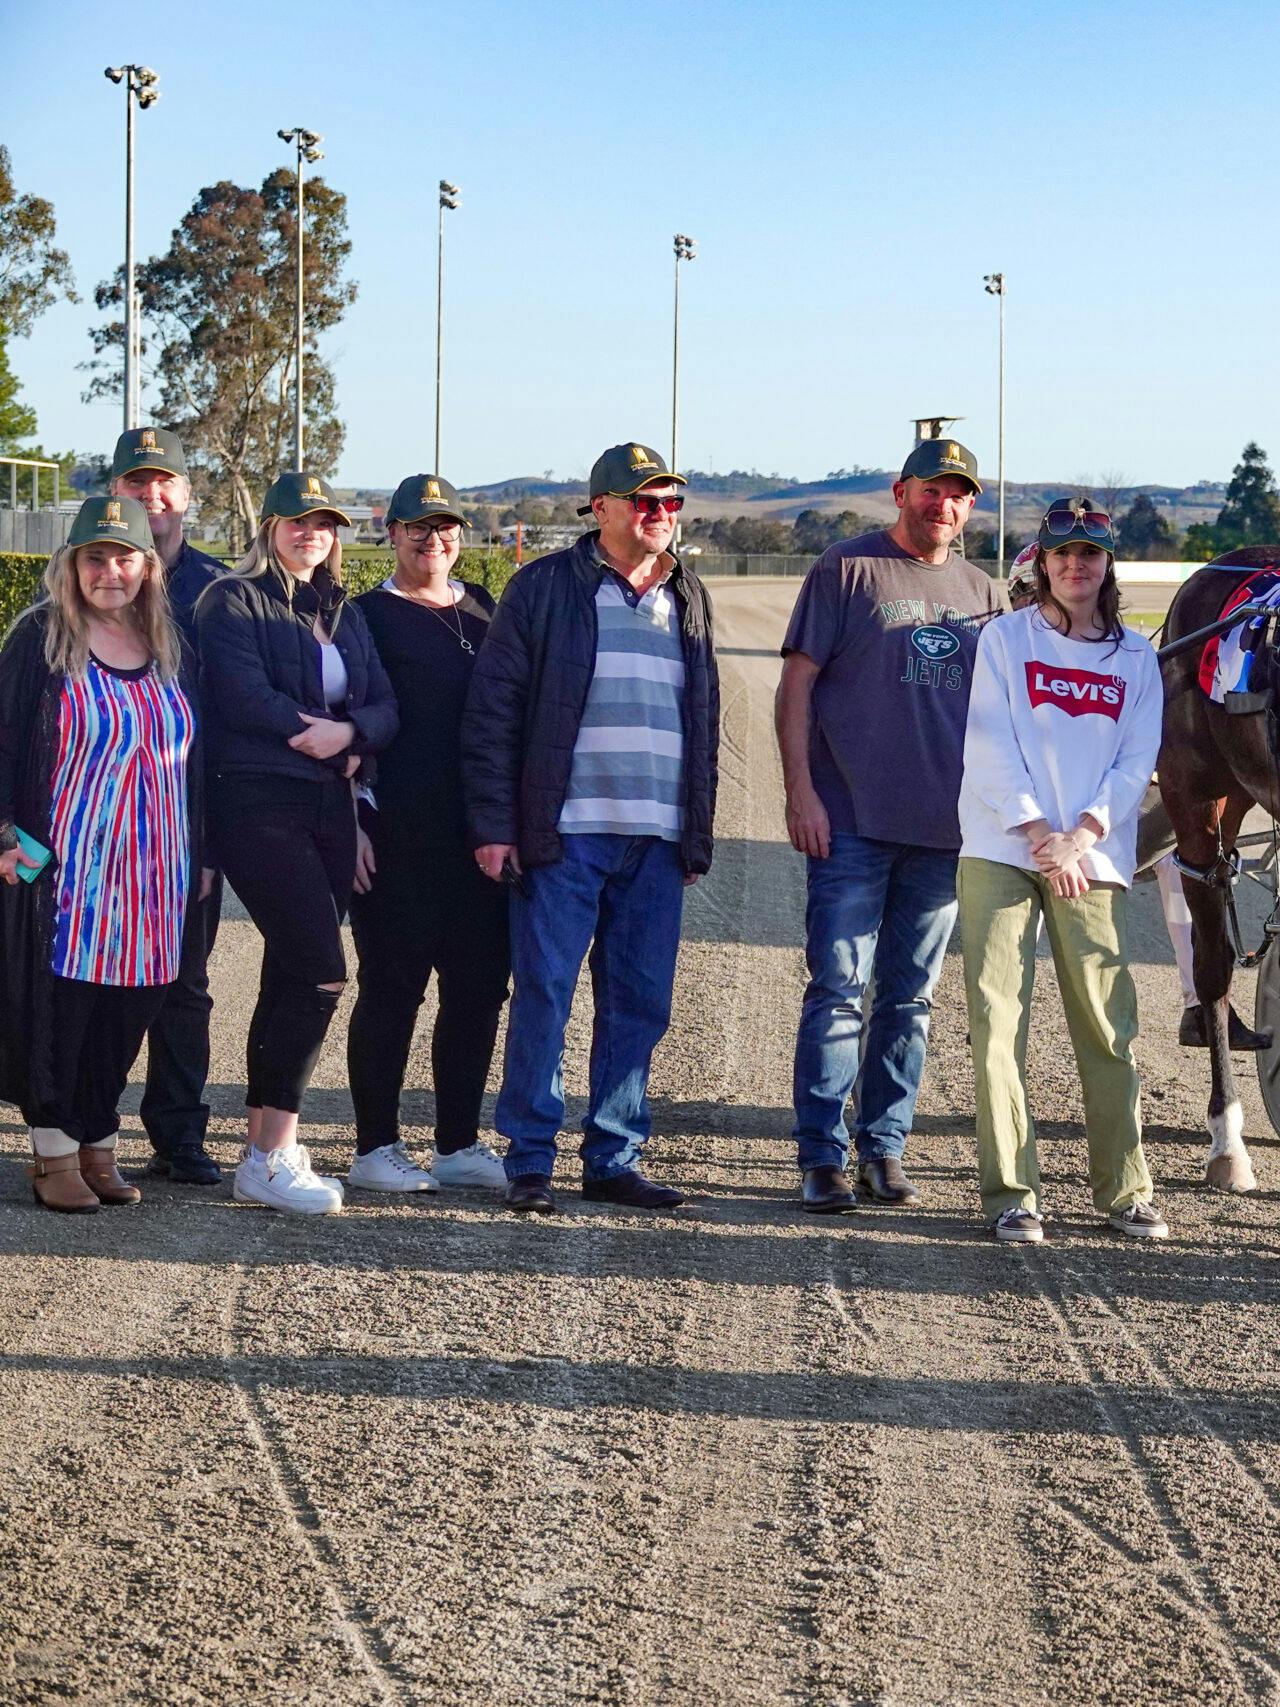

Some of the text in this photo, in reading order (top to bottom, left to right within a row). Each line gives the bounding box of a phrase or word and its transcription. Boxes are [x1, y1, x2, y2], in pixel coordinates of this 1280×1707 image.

[881, 600, 926, 624] NEW
[917, 637, 953, 650] JETS
[900, 656, 963, 691] JETS
